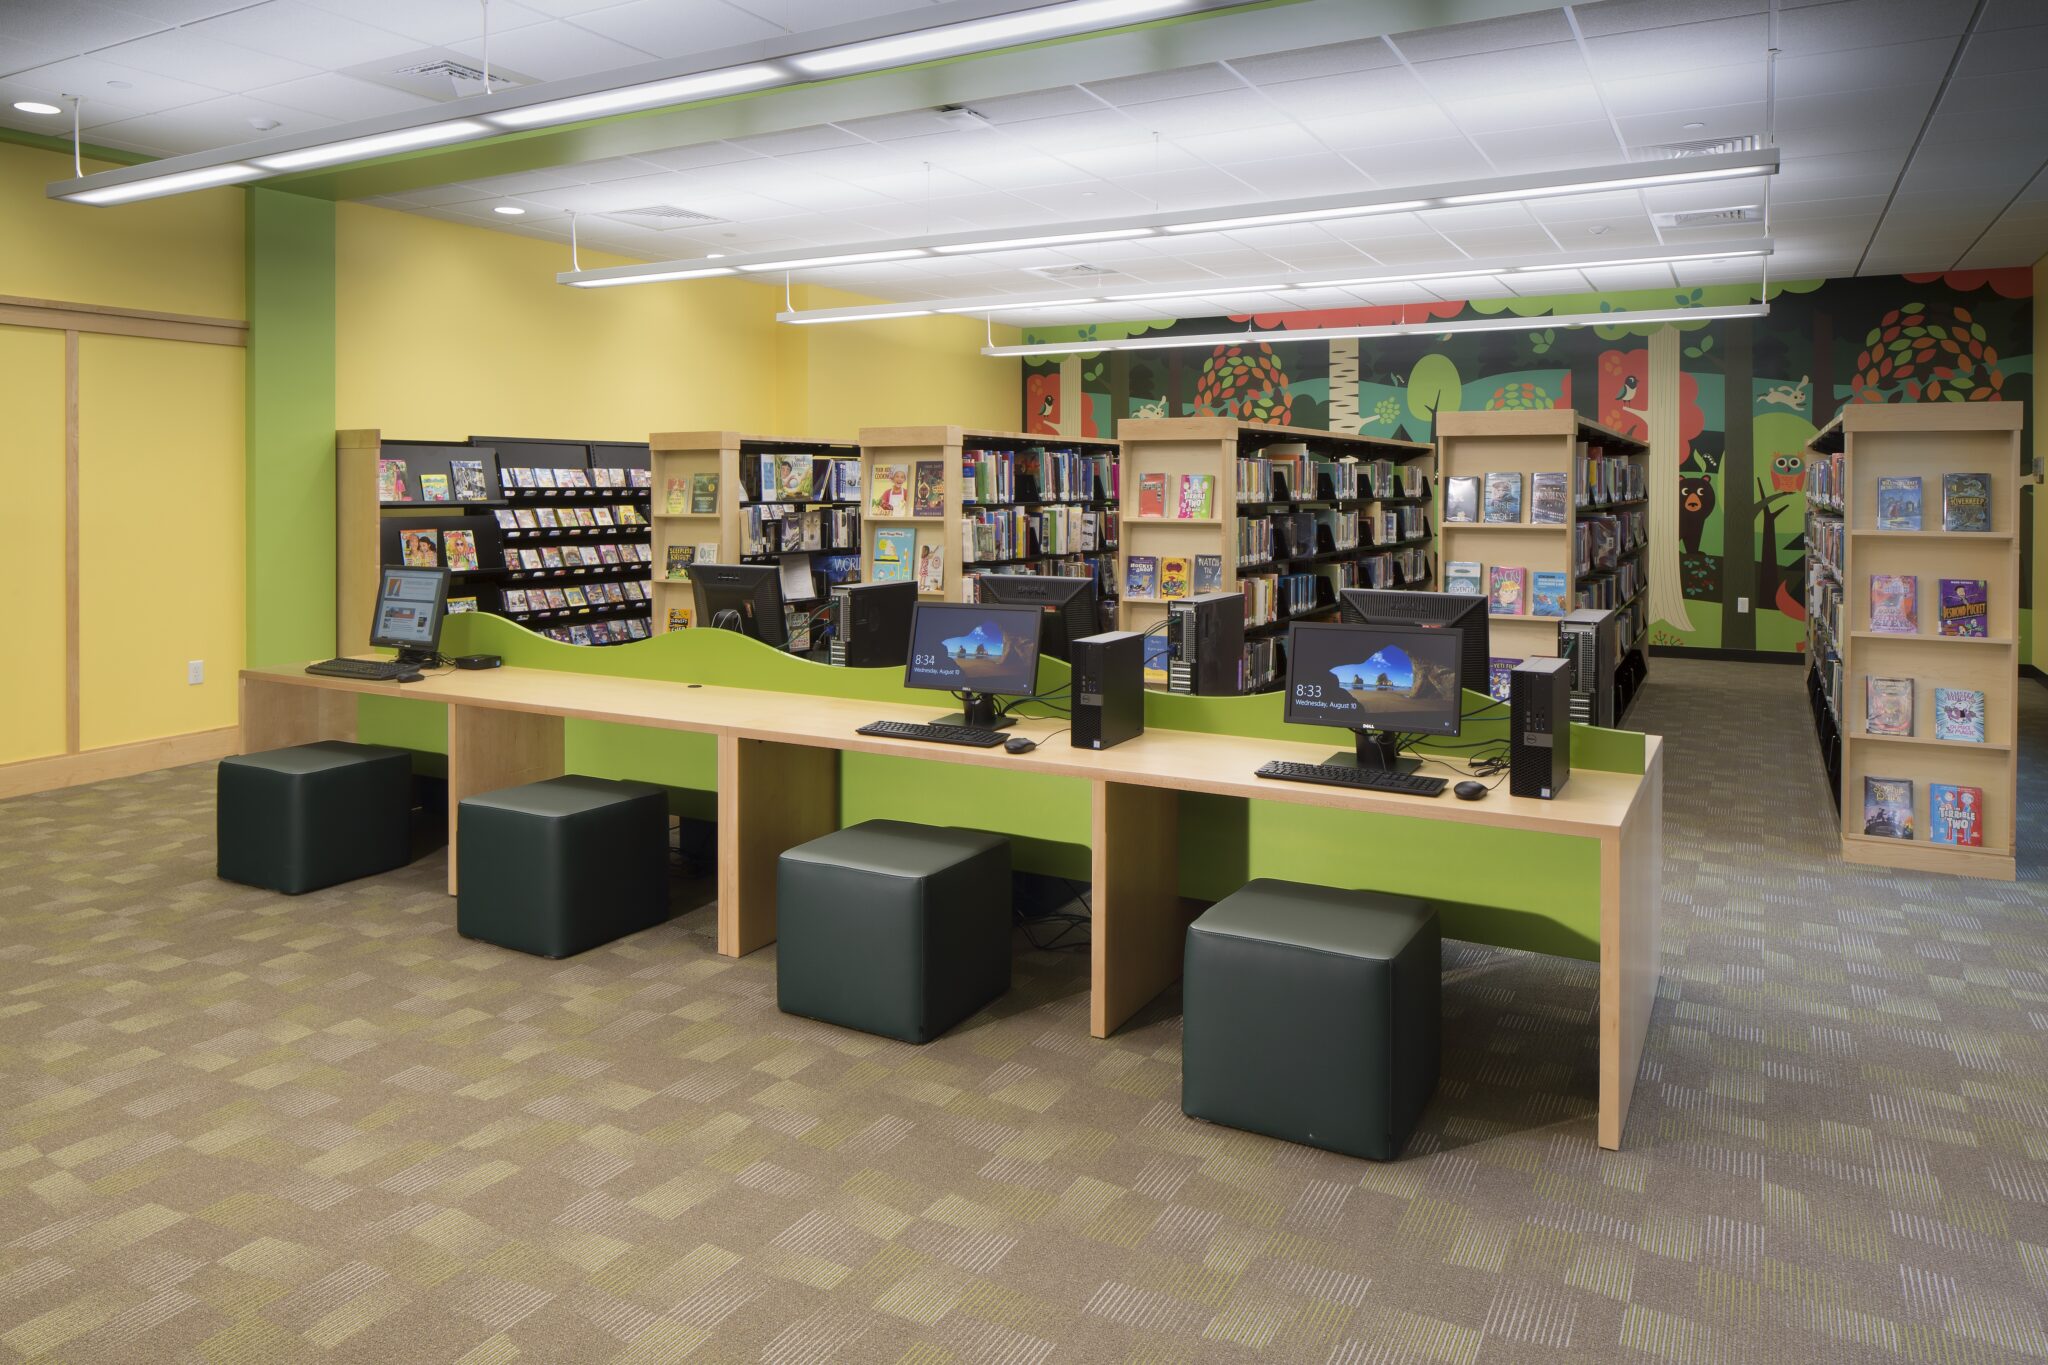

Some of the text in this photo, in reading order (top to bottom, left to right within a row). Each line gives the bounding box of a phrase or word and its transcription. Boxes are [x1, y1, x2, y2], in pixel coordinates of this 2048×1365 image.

[915, 655, 935, 666] 8:34
[1296, 684, 1322, 698] 8:33
[1295, 698, 1357, 710] Wednesday, August 10
[1939, 806, 1976, 821] TERRIBLE
[1946, 817, 1969, 830] TWO
